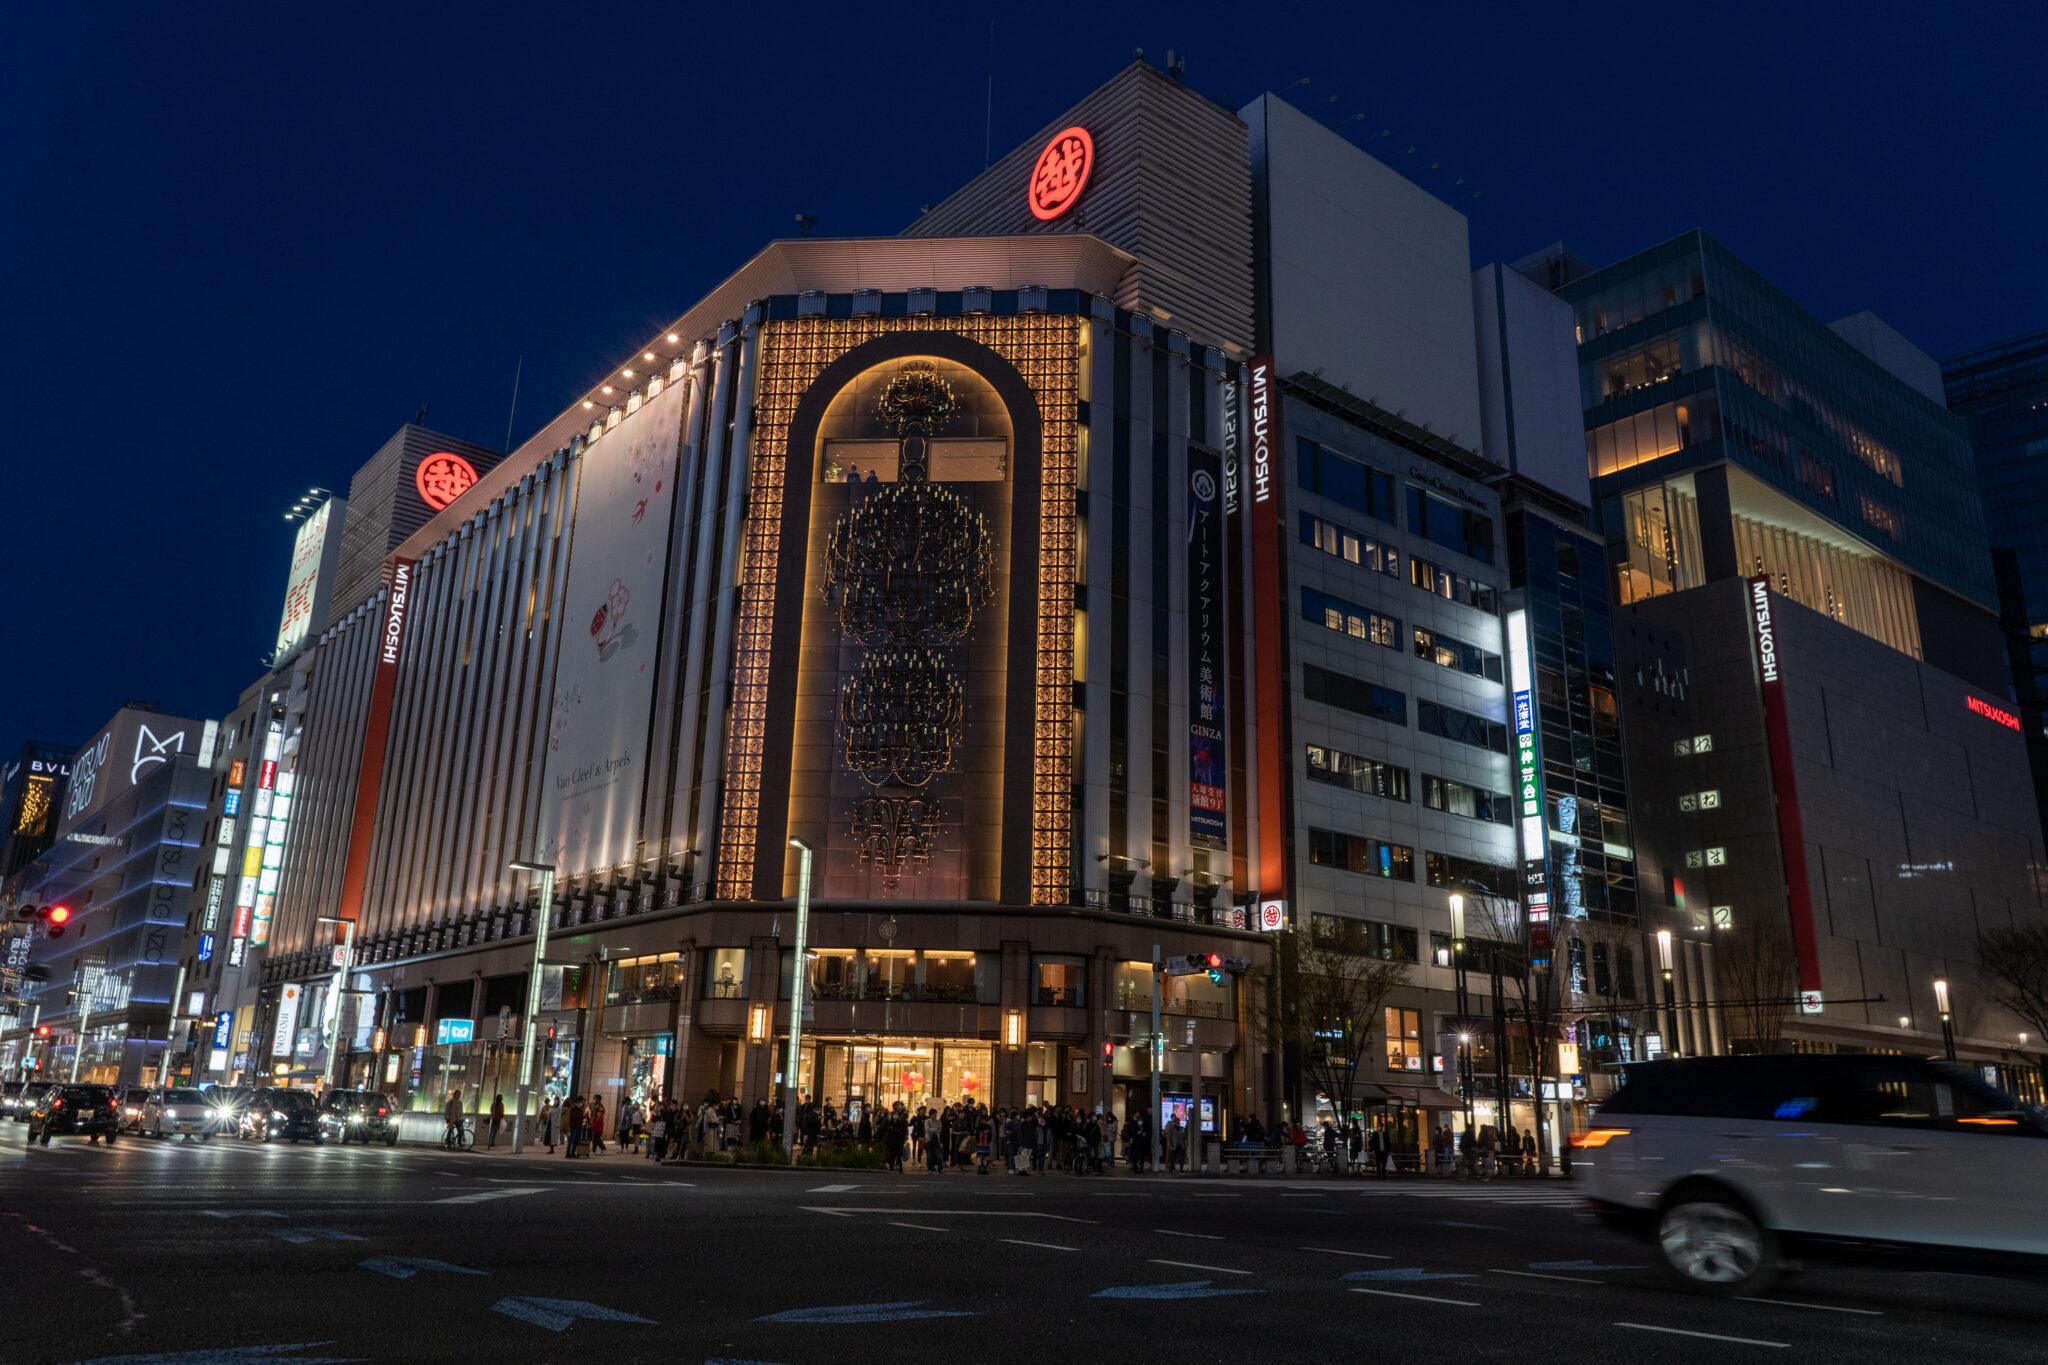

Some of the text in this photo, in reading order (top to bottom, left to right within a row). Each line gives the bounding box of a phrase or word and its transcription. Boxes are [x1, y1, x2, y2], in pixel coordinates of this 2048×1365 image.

[1253, 364, 1270, 503] MITSUKOSHI
[383, 563, 410, 664] MITSUKOSHI
[1199, 509, 1214, 721] アートアクアリウム美術館
[1753, 581, 1778, 683] MITSUKOSHI
[1190, 723, 1223, 741] GINZA
[1967, 694, 2021, 732] MITSUKOSHI
[555, 774, 571, 790] Van
[572, 761, 594, 786] Cleef
[595, 765, 602, 777] &
[604, 750, 631, 776] Arpels
[1191, 783, 1223, 799] 入場受付
[1191, 794, 1223, 811] 新館9F
[1190, 815, 1223, 828] MITSUKOSHI
